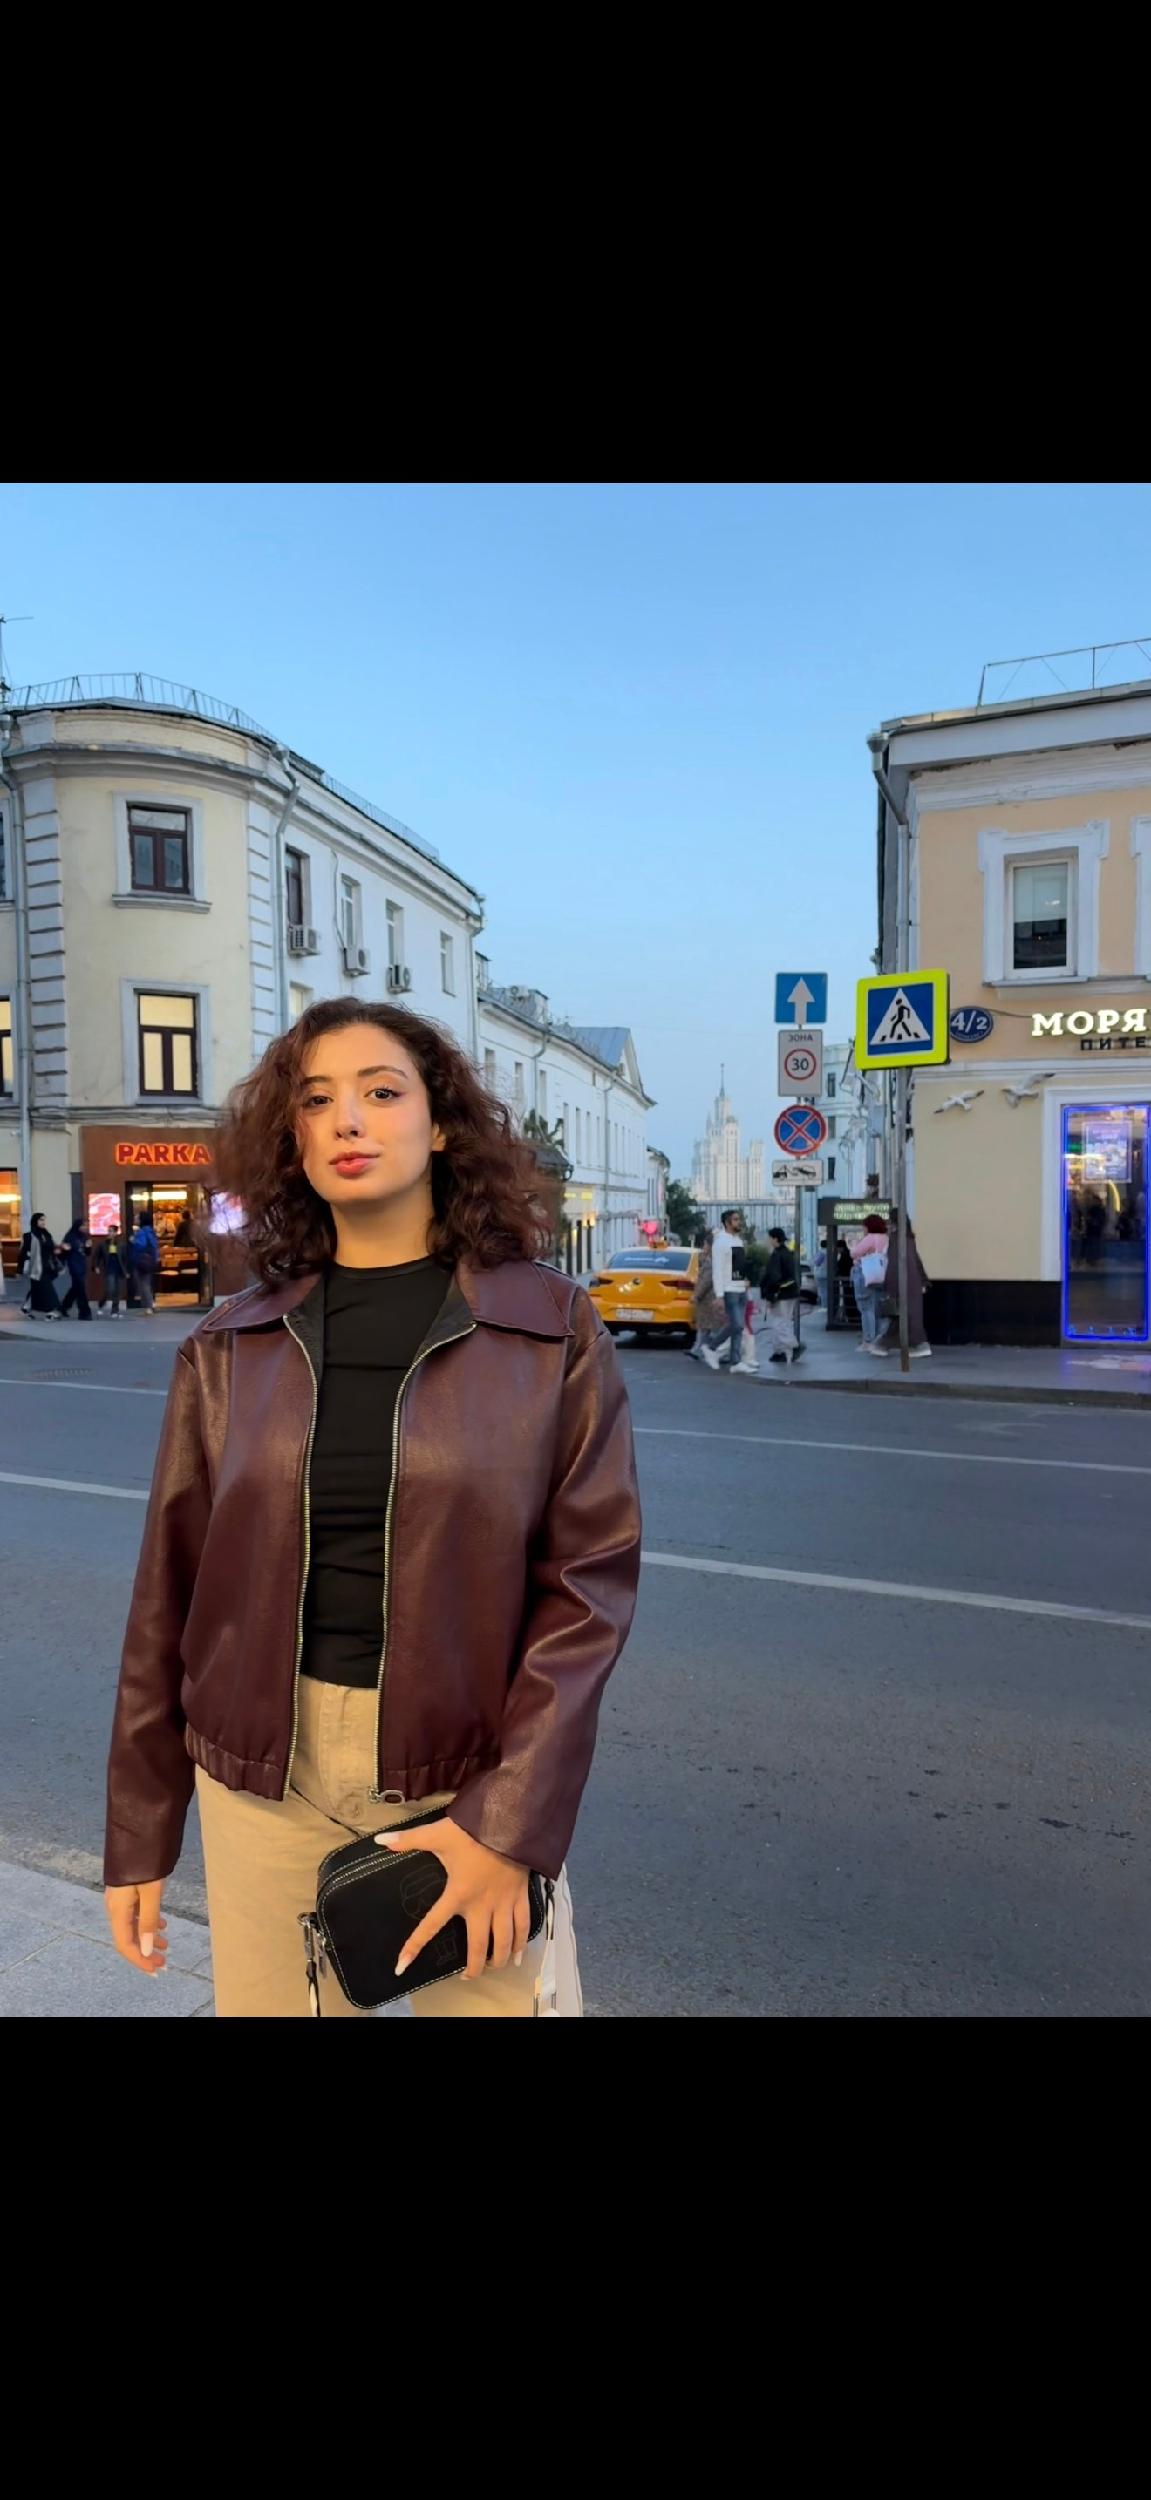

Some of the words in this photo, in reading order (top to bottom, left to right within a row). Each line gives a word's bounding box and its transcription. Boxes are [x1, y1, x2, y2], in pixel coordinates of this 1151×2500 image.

[951, 1011, 988, 1033] 4/2
[788, 1033, 814, 1042] ЗОНА
[791, 1057, 809, 1071] 30
